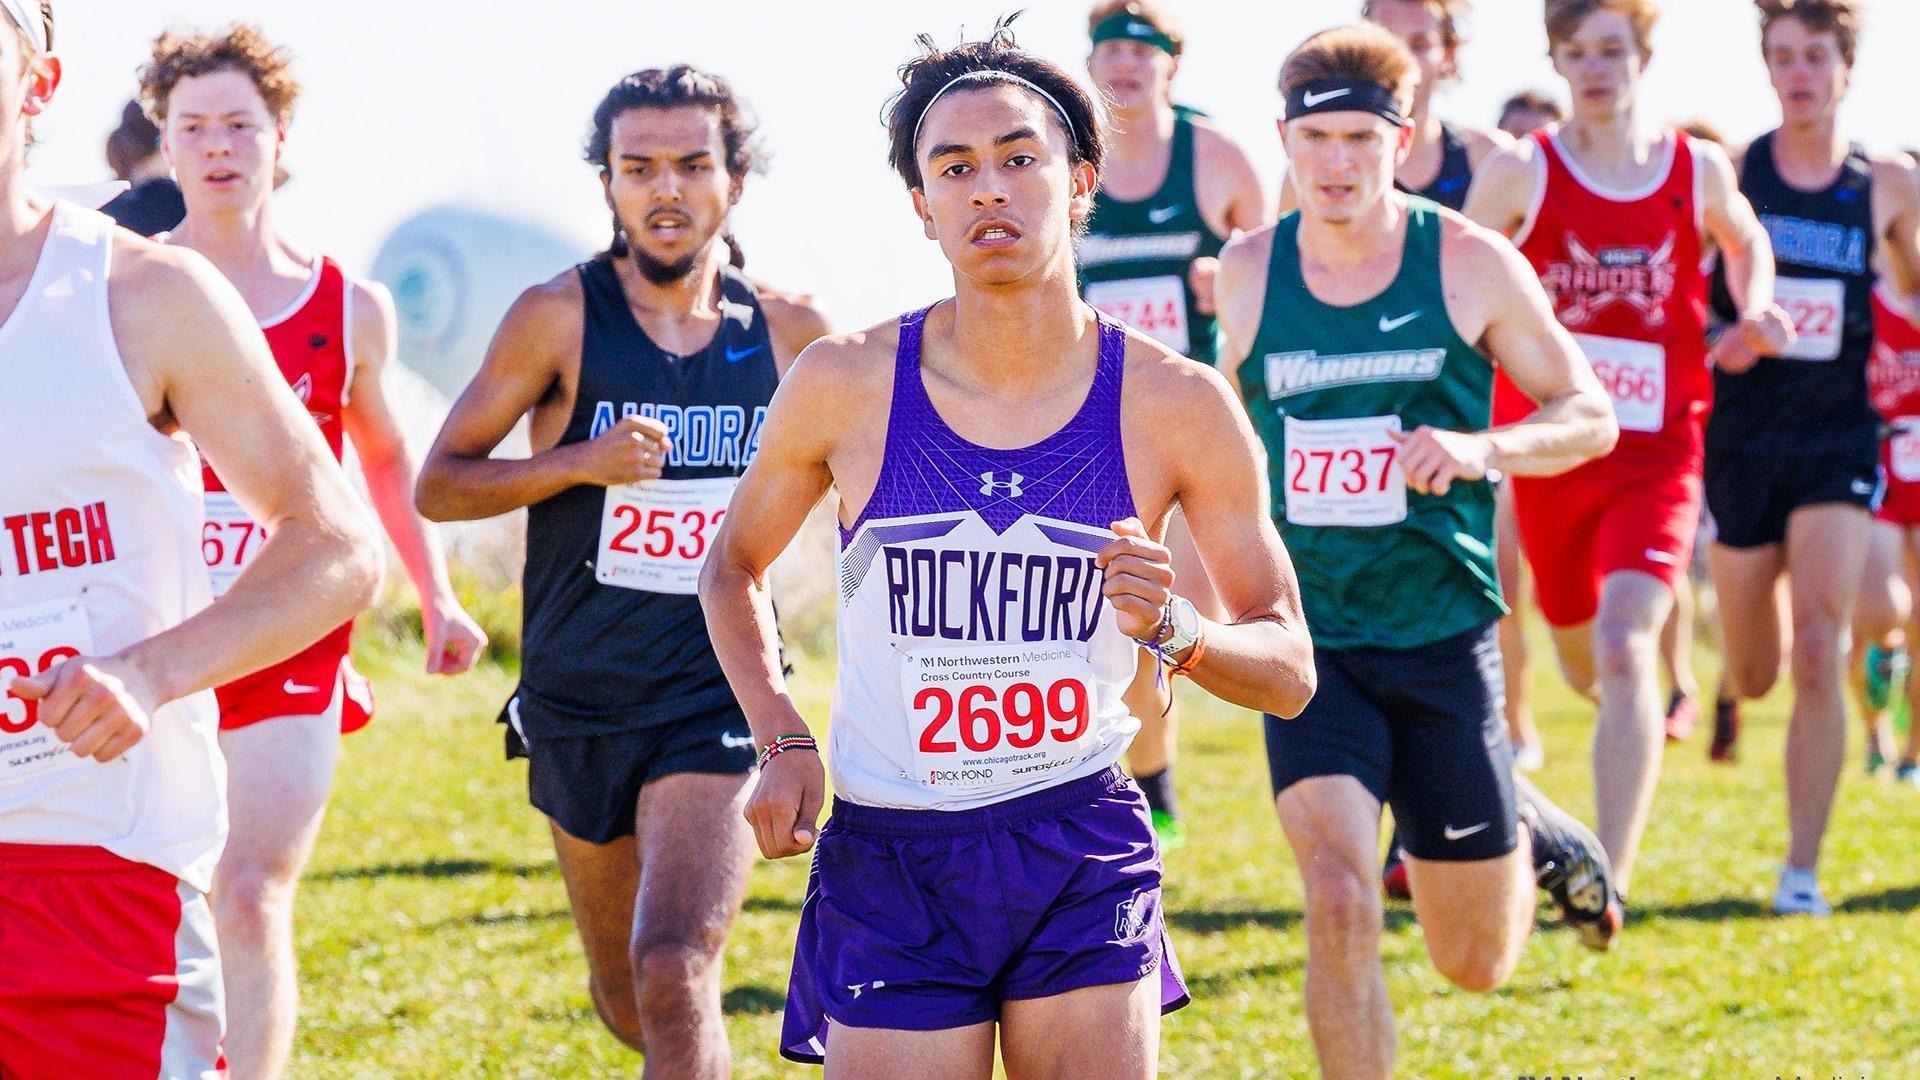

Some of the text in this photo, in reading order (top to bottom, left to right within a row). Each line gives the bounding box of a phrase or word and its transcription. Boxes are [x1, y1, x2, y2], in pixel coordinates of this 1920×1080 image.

[1266, 350, 1444, 398] WARRIORS
[1291, 447, 1396, 494] 2737
[3, 500, 115, 576] TECH
[609, 504, 727, 560] 253
[882, 546, 1106, 643] ROCKFORD
[921, 668, 1031, 682] Cross Country Course
[937, 654, 1020, 668] Northwestern
[1022, 649, 1072, 663] Medicine
[913, 678, 1090, 754] 2699
[936, 768, 993, 781] DICK POND
[962, 752, 1047, 766] www.chicagotrack.org
